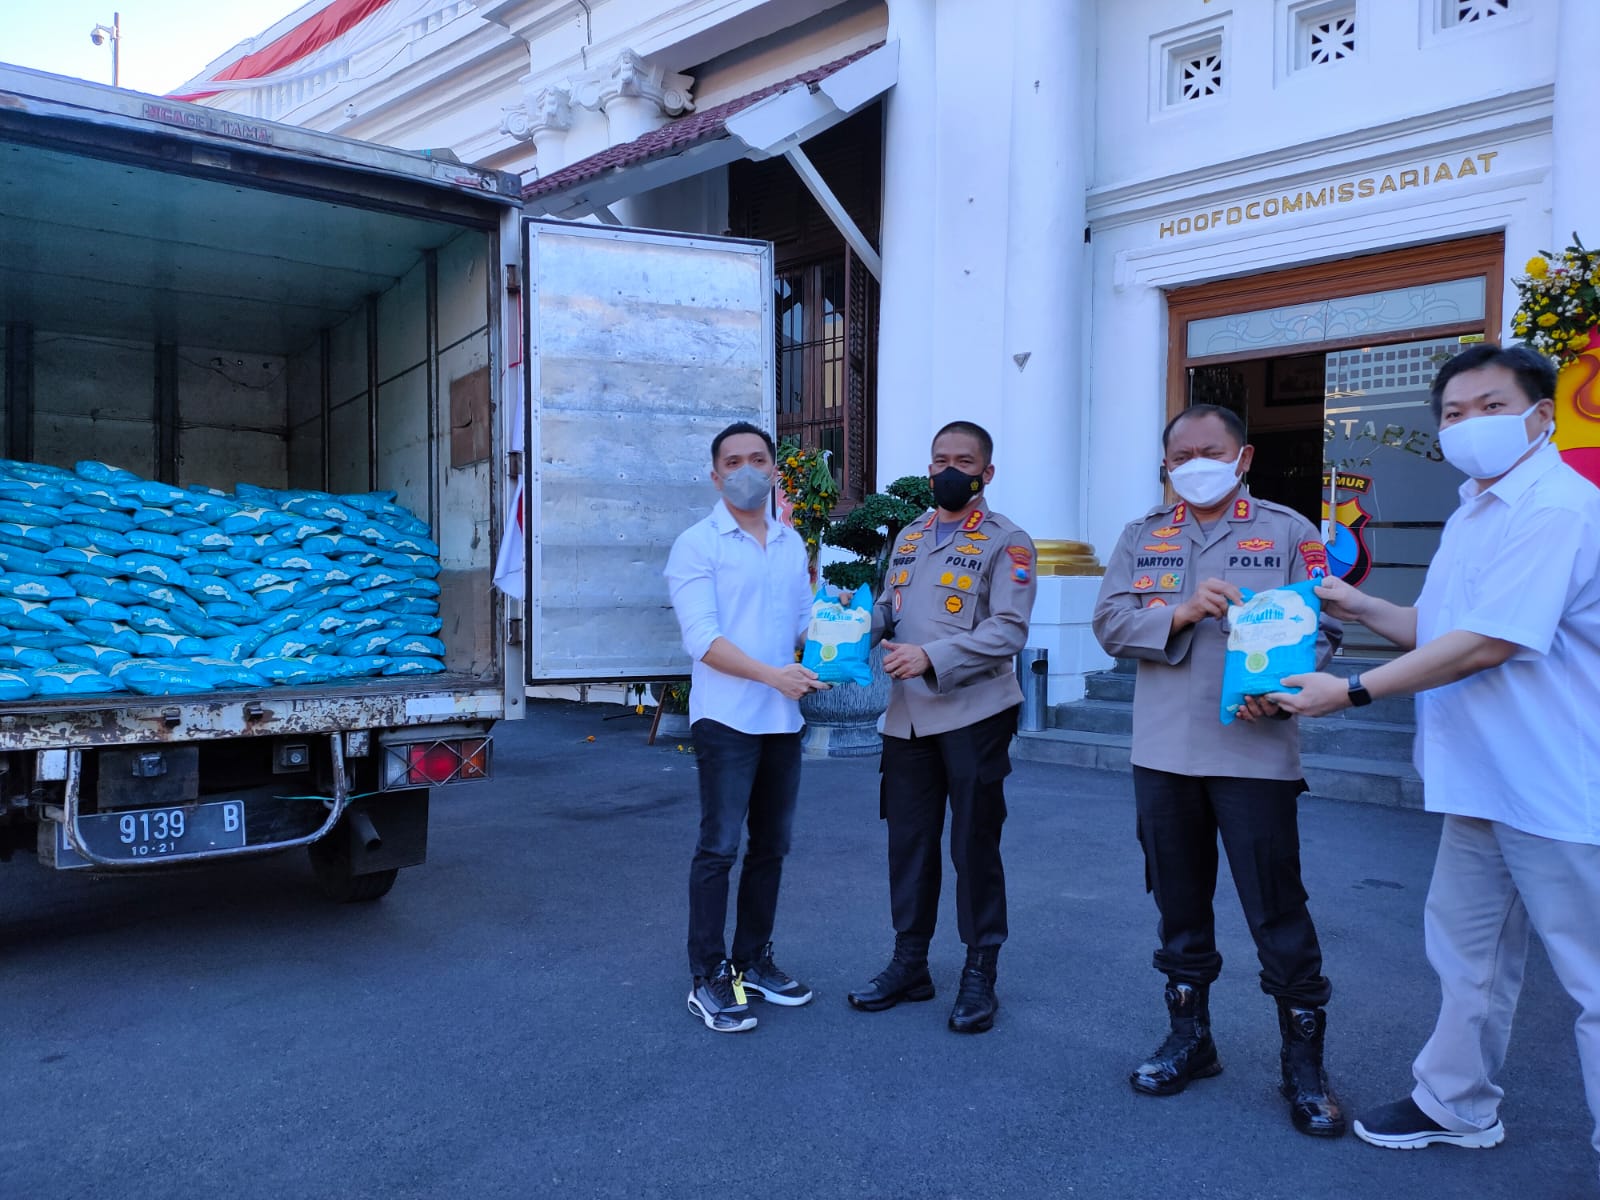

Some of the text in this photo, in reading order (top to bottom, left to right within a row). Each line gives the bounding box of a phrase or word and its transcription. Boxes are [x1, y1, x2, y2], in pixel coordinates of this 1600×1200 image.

[1159, 151, 1498, 239] HOOFDCOMMISSARIAAT
[1322, 476, 1366, 490] TMUR
[945, 556, 983, 572] POLRI
[1137, 556, 1184, 568] HARTOYO
[1229, 556, 1281, 568] POLRI
[119, 810, 185, 843] 9139
[223, 804, 239, 832] B
